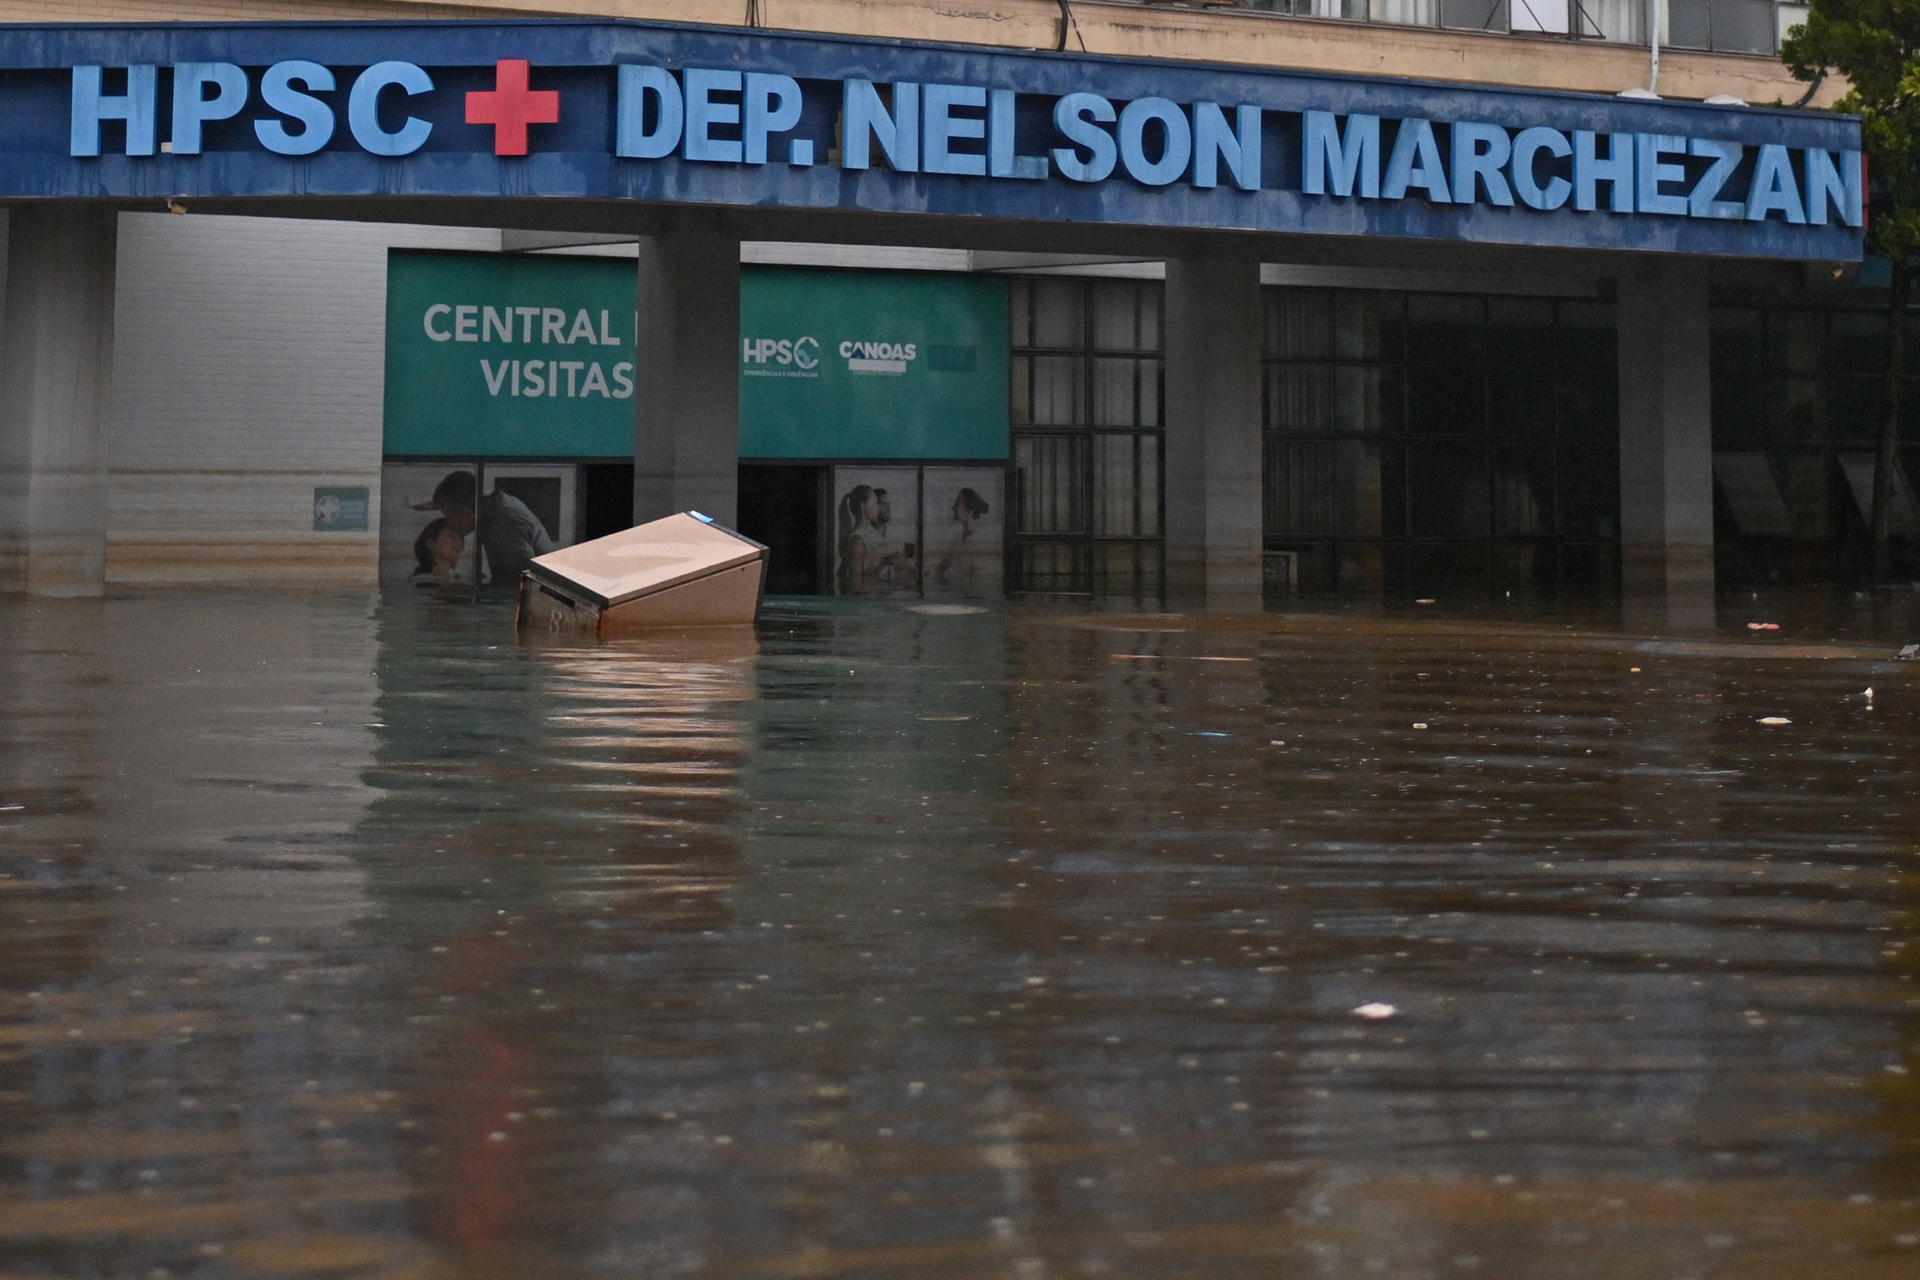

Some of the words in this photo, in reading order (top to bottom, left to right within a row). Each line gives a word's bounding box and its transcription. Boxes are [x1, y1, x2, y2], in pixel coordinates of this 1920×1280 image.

[70, 60, 436, 157] HPSC
[616, 64, 814, 166] DEP.
[842, 78, 1262, 192] NELSON
[1301, 110, 1863, 229] MARCHEZAN
[423, 303, 620, 346] CENTRAL
[743, 336, 819, 369] HPSC
[839, 340, 917, 361] CANOAS
[480, 359, 634, 399] VISITAS
